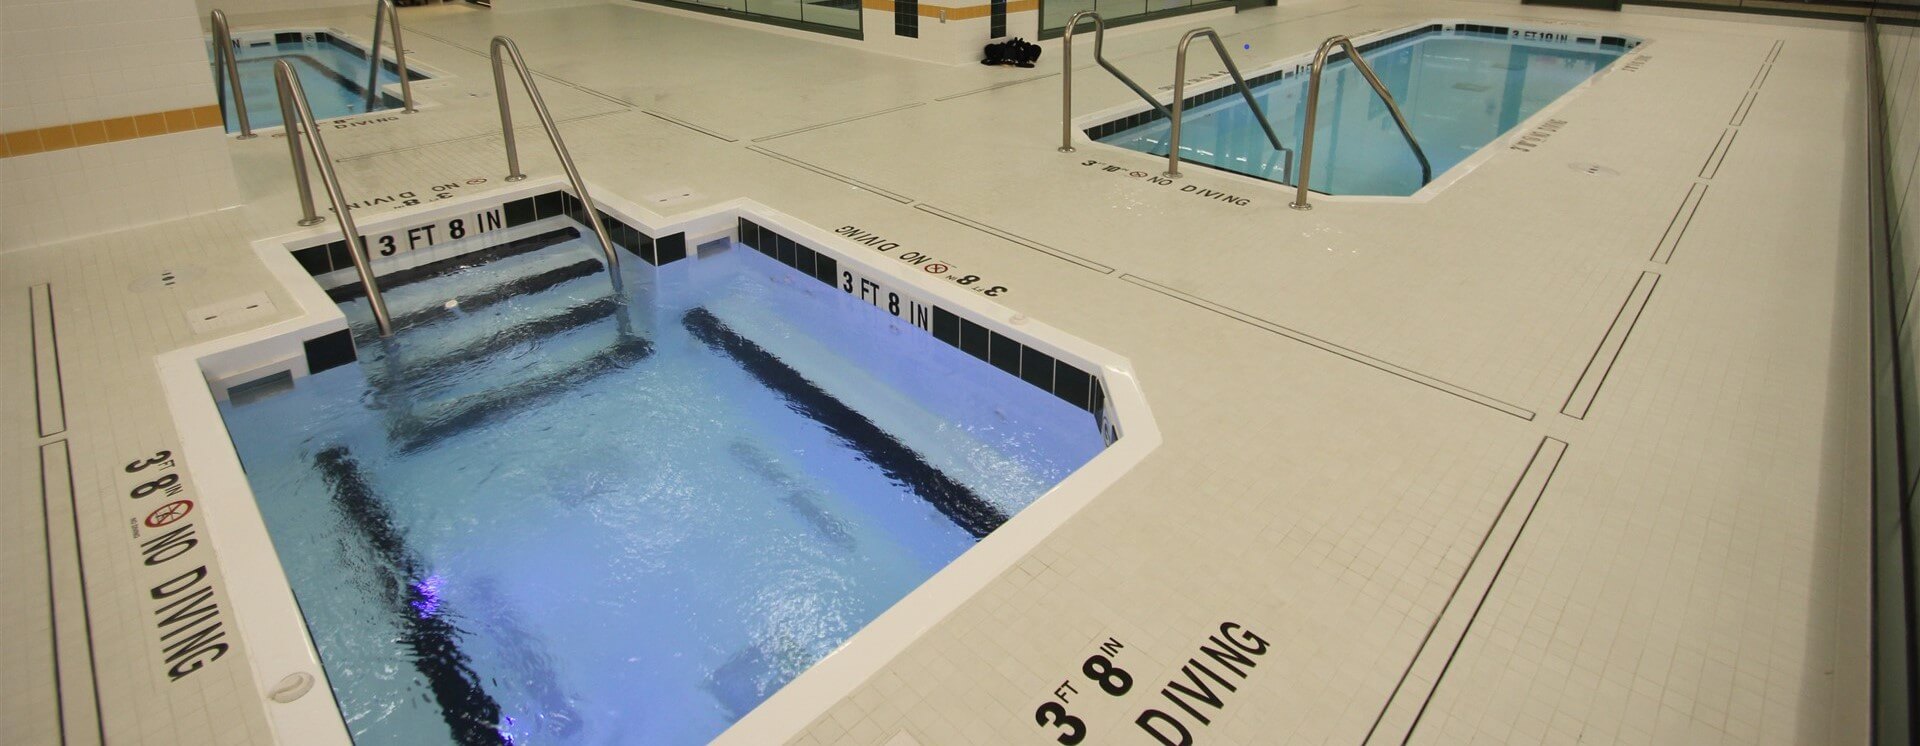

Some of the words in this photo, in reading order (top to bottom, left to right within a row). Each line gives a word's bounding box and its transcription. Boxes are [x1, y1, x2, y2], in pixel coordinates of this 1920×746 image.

[1524, 31, 1538, 40] FT
[334, 116, 399, 130] DIVING
[432, 182, 460, 192] NO
[1102, 165, 1121, 173] 10
[1147, 176, 1173, 186] NO
[1180, 184, 1251, 207] DIVING
[379, 235, 397, 256] 3
[407, 224, 436, 250] FT
[449, 218, 466, 240] 8
[477, 209, 502, 233] IN
[834, 225, 899, 252] DIVING
[899, 251, 932, 265] NO
[956, 274, 981, 286] 8
[984, 285, 1008, 297] 3
[842, 270, 854, 294] 3
[861, 277, 880, 307] FT
[888, 292, 900, 317] 8
[910, 300, 928, 331] IN
[130, 473, 179, 499] 8
[140, 523, 199, 566] NO
[150, 565, 229, 683] DIVING
[1135, 621, 1271, 746] DIVING
[1035, 701, 1087, 746] 3
[1081, 654, 1133, 697] 8
